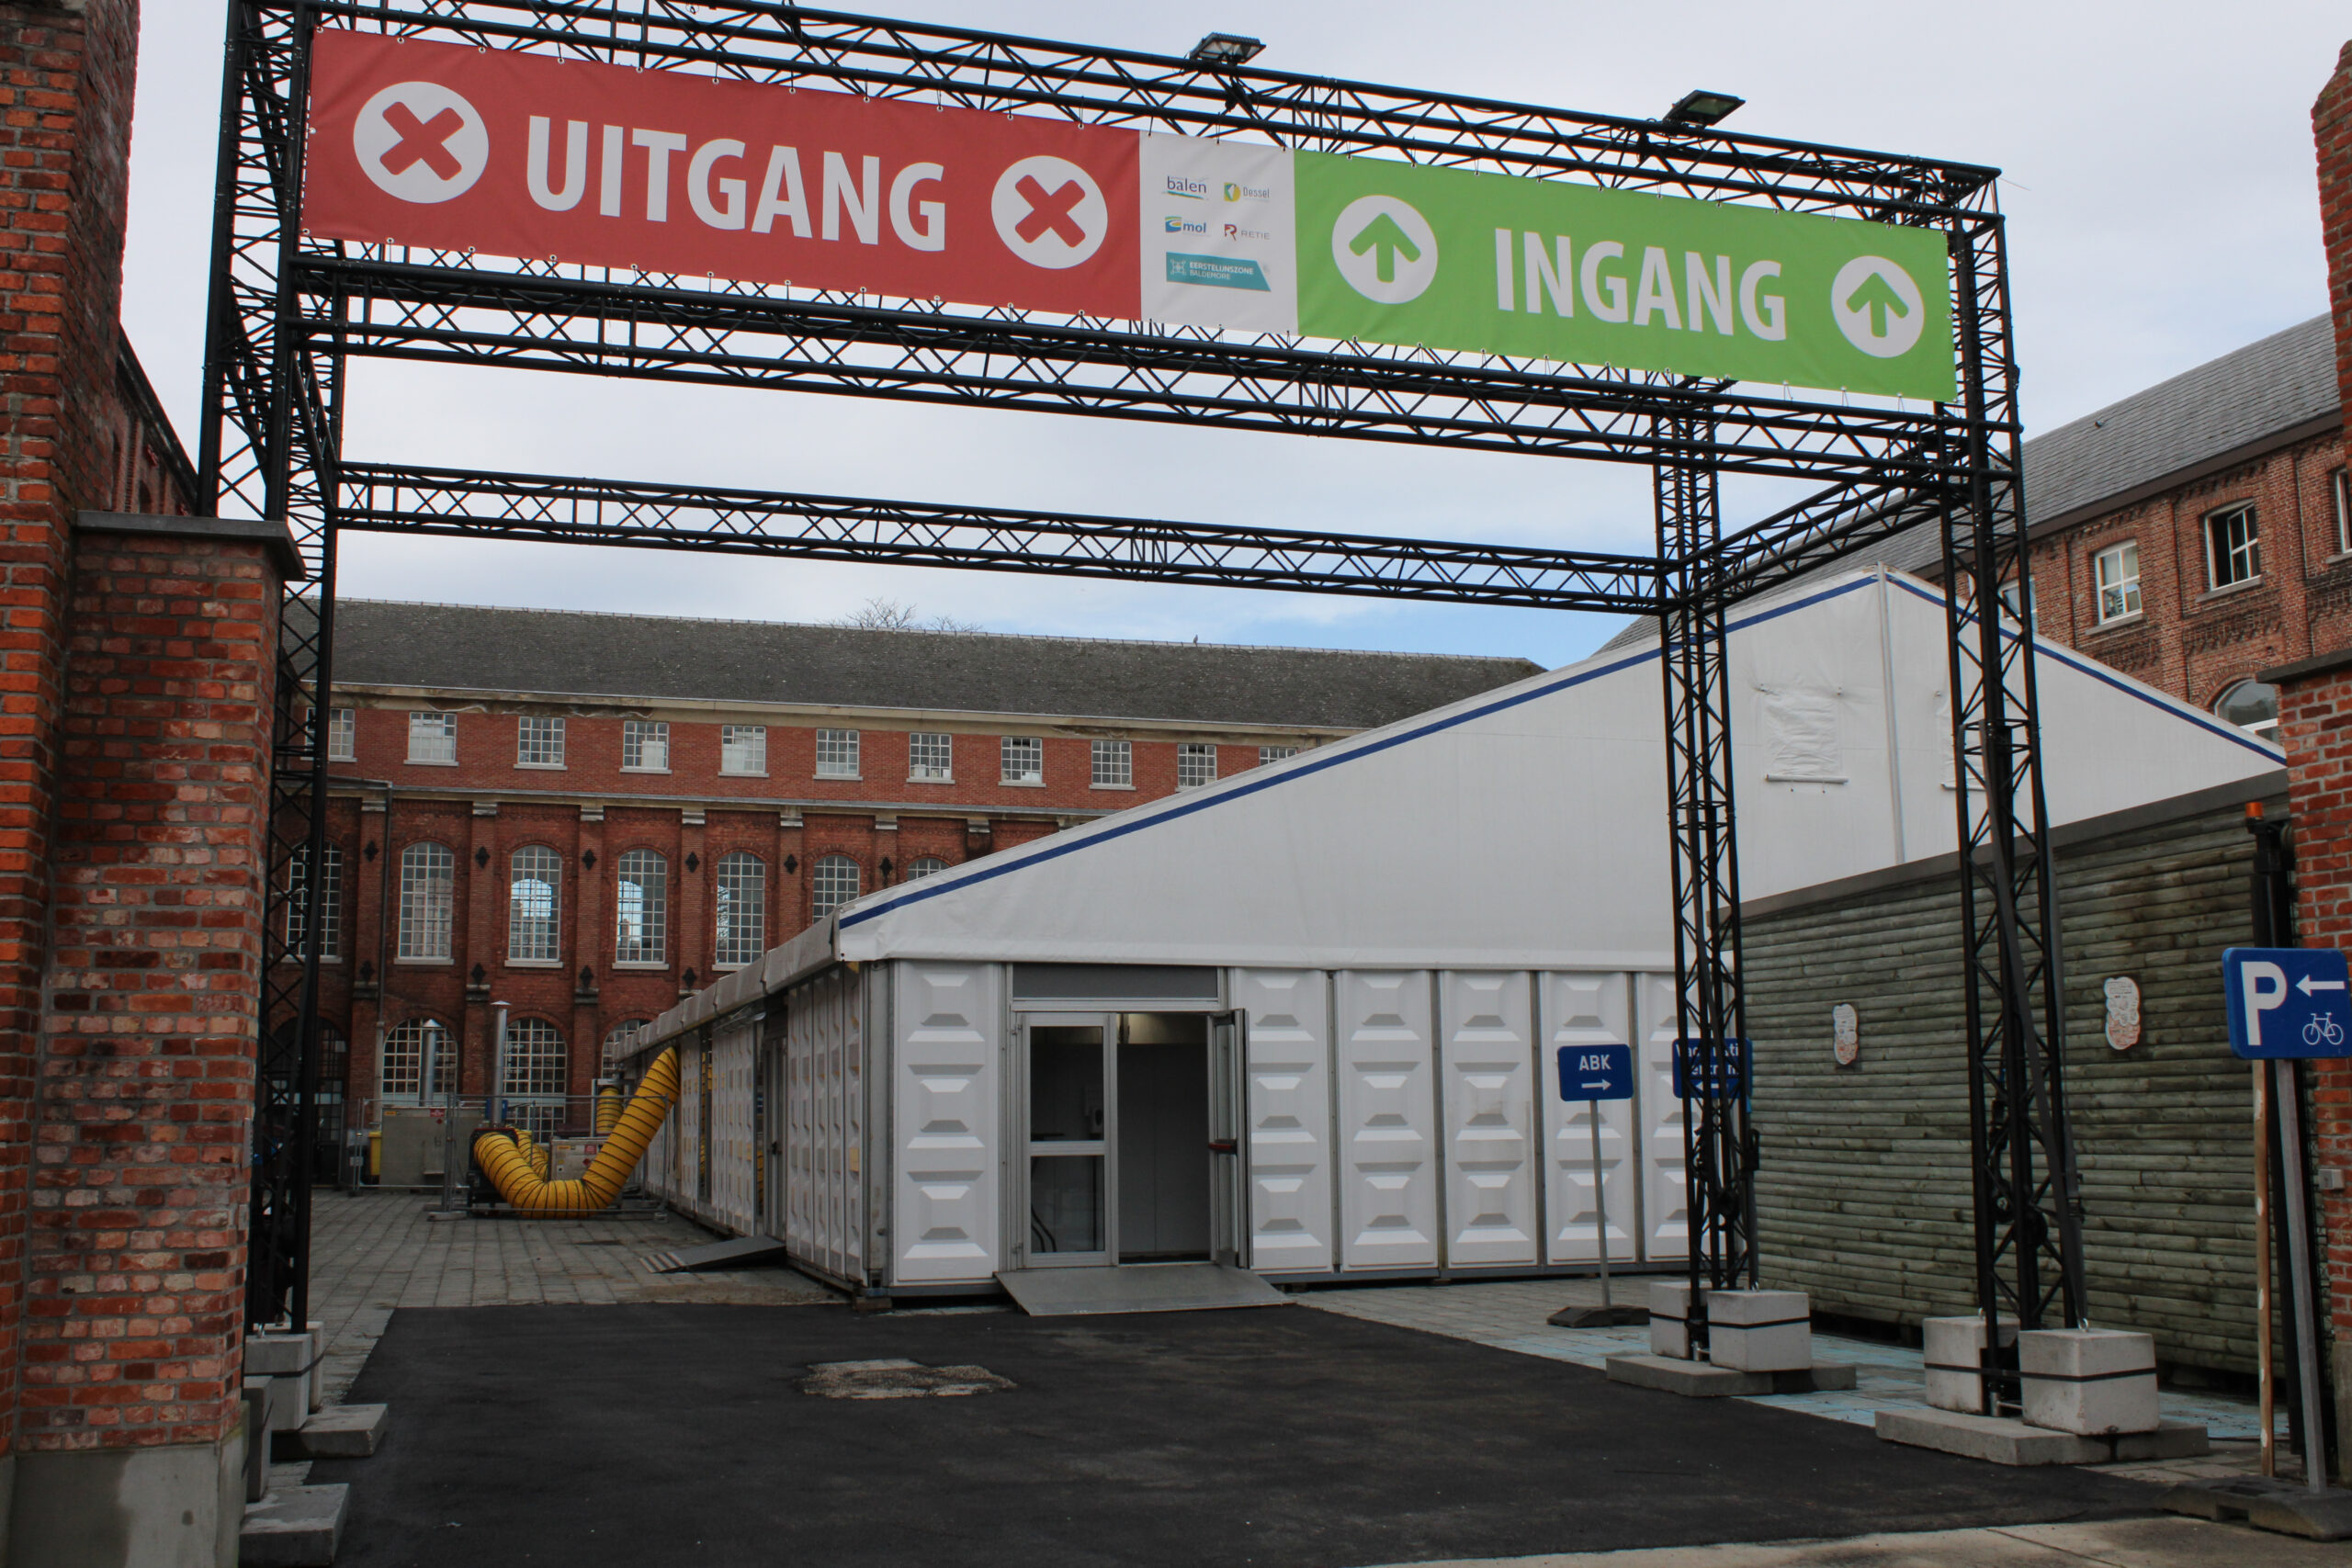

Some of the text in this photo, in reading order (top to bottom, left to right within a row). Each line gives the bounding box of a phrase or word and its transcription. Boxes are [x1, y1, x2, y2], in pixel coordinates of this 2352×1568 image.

[526, 115, 945, 252] UITGANG
[1167, 175, 1207, 193] balen
[1243, 186, 1270, 198] Dessel
[1183, 223, 1206, 233] mol
[1241, 231, 1271, 241] RETIE
[1190, 270, 1230, 279] BALDEMORE
[1494, 228, 1787, 342] INGANG
[2240, 961, 2288, 1046] P
[1578, 1055, 1611, 1071] ABK
